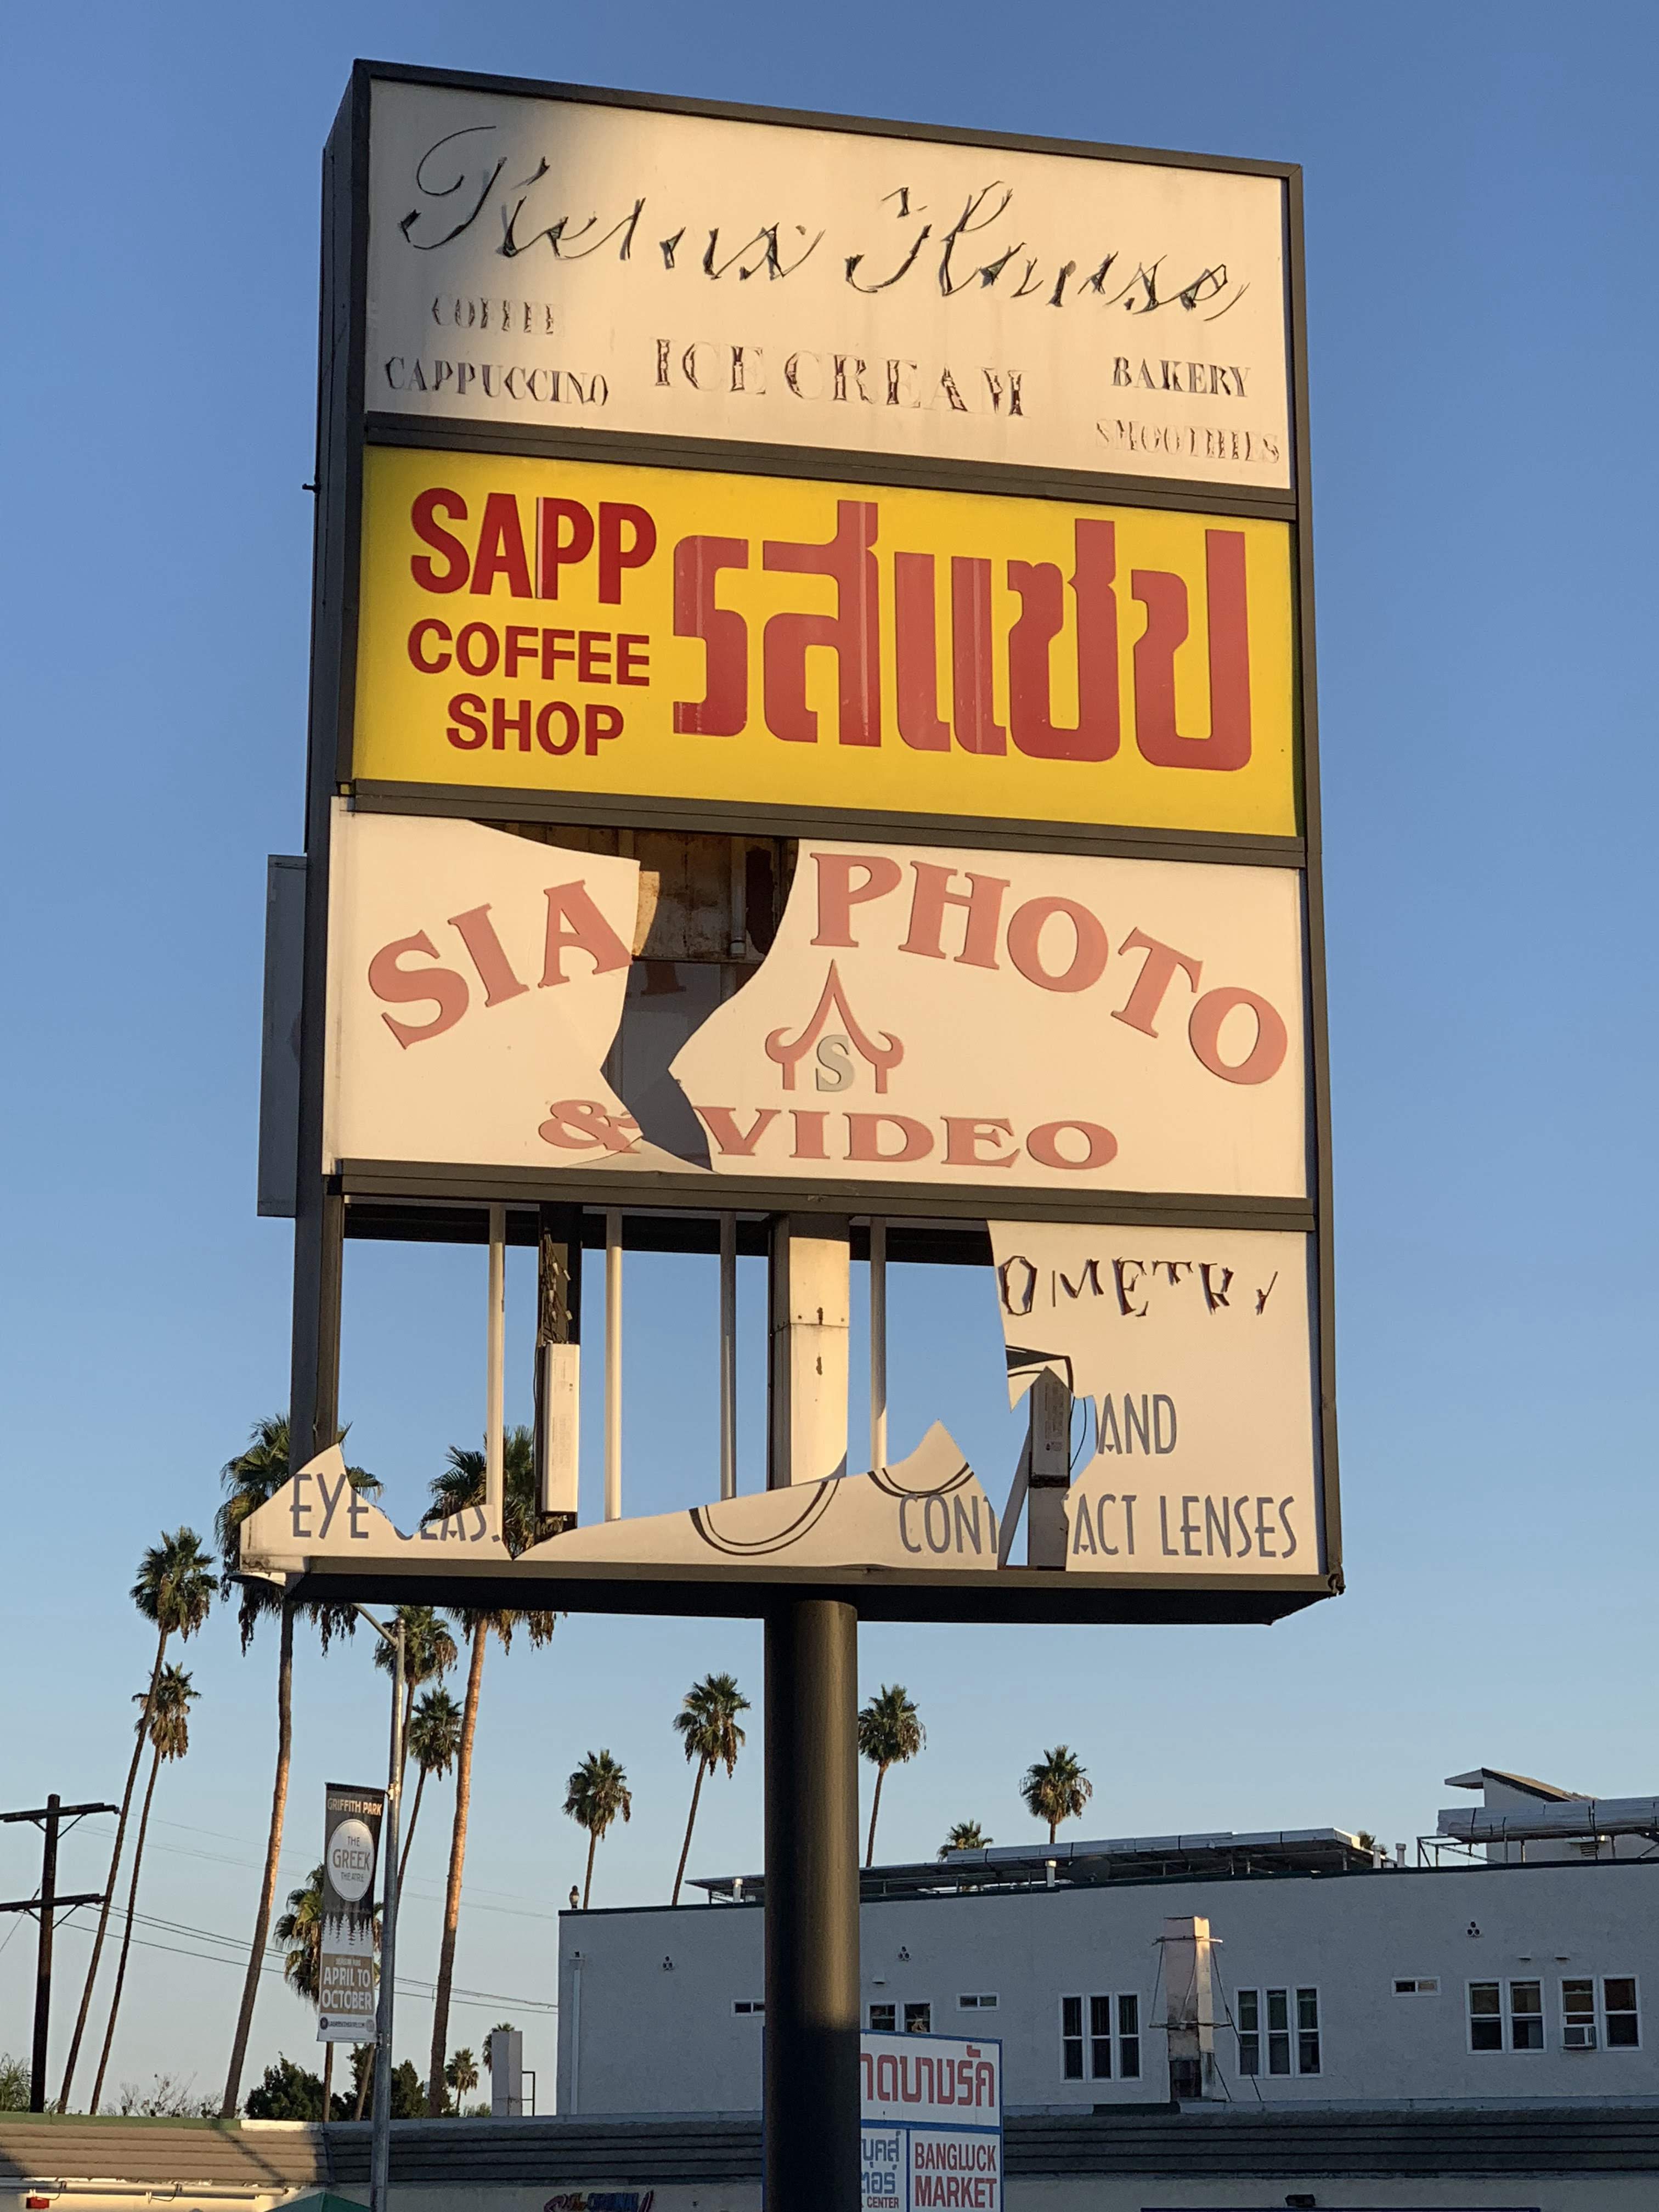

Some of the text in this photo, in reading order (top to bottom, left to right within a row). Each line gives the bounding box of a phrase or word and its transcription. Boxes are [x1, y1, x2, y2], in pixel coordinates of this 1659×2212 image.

[385, 356, 609, 407] CAPPUCCINO
[654, 338, 1029, 416] ICE CREAM
[1111, 356, 1251, 398] BAKERY
[410, 487, 657, 605] SAPP
[408, 618, 650, 686] COFFEE
[447, 693, 624, 757] SHOP
[810, 853, 1288, 1085] PHOTO
[538, 1099, 1118, 1170] & VIDEO
[1098, 1393, 1177, 1455] AND
[290, 1473, 369, 1539] EYE
[1160, 1495, 1297, 1559] LENSES
[328, 1797, 382, 1816] GRIFFITH PARK
[332, 1848, 370, 1871] GREEK
[347, 1836, 360, 1847] THE
[341, 1871, 364, 1882] THEATRE
[321, 1989, 372, 2010] OCTOBER
[324, 1966, 370, 1988] APRIL TO
[915, 2142, 996, 2172] BANGLUCK
[867, 2196, 899, 2209] CENTER
[915, 2175, 997, 2209] MARKET
